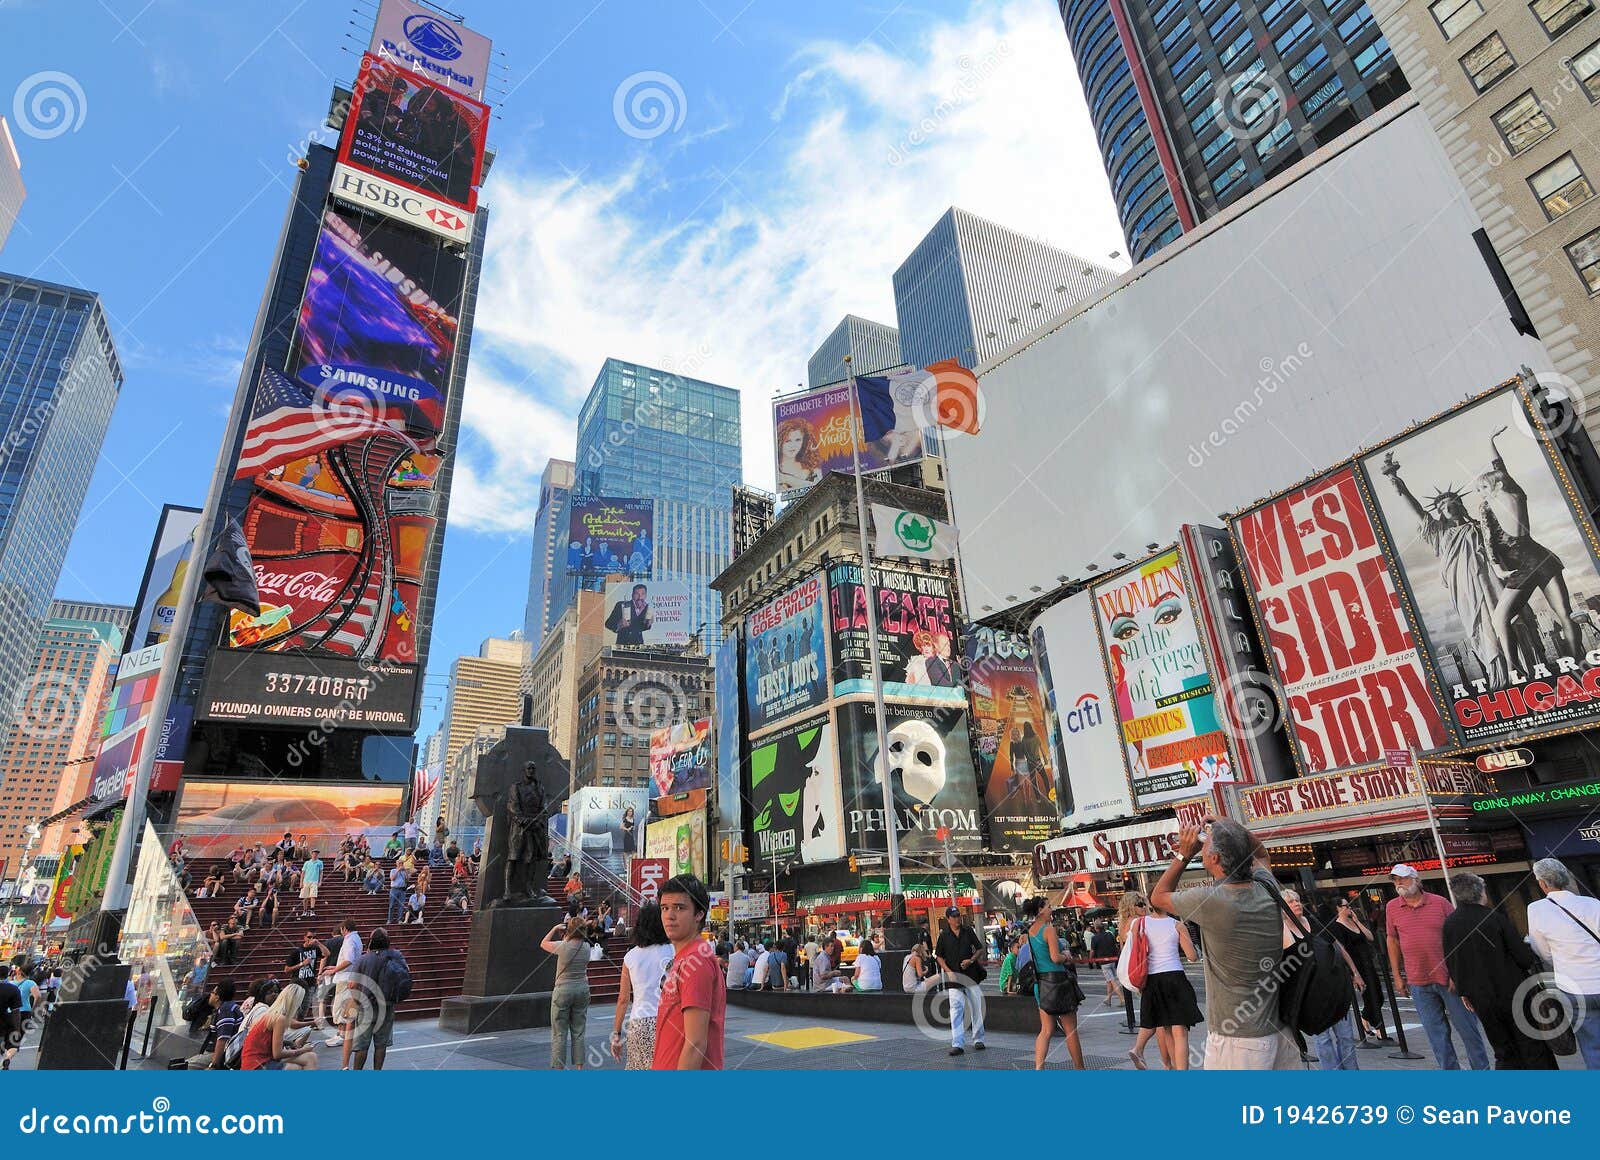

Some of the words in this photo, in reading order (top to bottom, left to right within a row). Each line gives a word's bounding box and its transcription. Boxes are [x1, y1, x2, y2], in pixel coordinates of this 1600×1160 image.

[382, 39, 474, 88] Prudential
[352, 147, 386, 165] power
[355, 138, 381, 153] solar
[383, 147, 419, 170] energy
[420, 163, 449, 181] could
[357, 127, 382, 143] 0.3%
[384, 138, 397, 149] of
[398, 144, 439, 167] Saharan
[339, 172, 423, 217] HSBC
[320, 364, 420, 401] SAMSUNG
[780, 396, 823, 418] BERNADETTE
[824, 390, 850, 408] PETERS
[582, 513, 641, 527] Addams
[600, 507, 626, 515] The
[587, 524, 637, 543] Family
[1240, 468, 1376, 592] WEST
[774, 578, 819, 614] CROWD
[882, 570, 917, 593] MUSICAL
[917, 575, 948, 597] REVIVAL
[1097, 560, 1185, 624] WOMEN
[752, 613, 782, 637] GOES
[831, 585, 869, 633] LA
[879, 590, 953, 641] CAGE
[1258, 556, 1418, 686] SIDE
[1120, 636, 1141, 664] on
[1141, 624, 1171, 656] the
[1151, 641, 1201, 676] verge
[380, 666, 413, 675] HYUNDAI
[756, 660, 791, 706] JERSEY
[791, 651, 819, 690] BOYS
[1130, 669, 1147, 704] of
[1163, 696, 1179, 706] NEW
[1180, 685, 1212, 700] MUSICAL
[1453, 677, 1488, 699] AT
[210, 701, 262, 715] HYUNDAI
[264, 704, 312, 718] OWNERS
[314, 707, 346, 720] CAN'T
[348, 709, 363, 721] BE
[365, 710, 407, 723] WRONG.
[894, 705, 924, 719] belongs
[1067, 699, 1103, 733] citi
[1124, 709, 1184, 740] NERVOUS
[1287, 663, 1452, 774] STORY
[156, 717, 176, 759] Travelex
[1148, 732, 1227, 768] BREAKDOWN
[1483, 751, 1527, 769] FUEL
[94, 766, 128, 800] Travelex
[1157, 778, 1187, 790] BELASCO
[1249, 785, 1294, 822] WEST
[1298, 774, 1347, 811] SIDE
[1350, 766, 1410, 802] STORY
[589, 796, 603, 810] &
[607, 794, 637, 810] isles
[1472, 795, 1510, 812] GOING
[849, 808, 978, 834] PHANTOM
[1034, 844, 1089, 878] GUEST
[1091, 831, 1181, 869] SUITES
[872, 890, 892, 900] sba
[910, 889, 940, 899] sbarro
